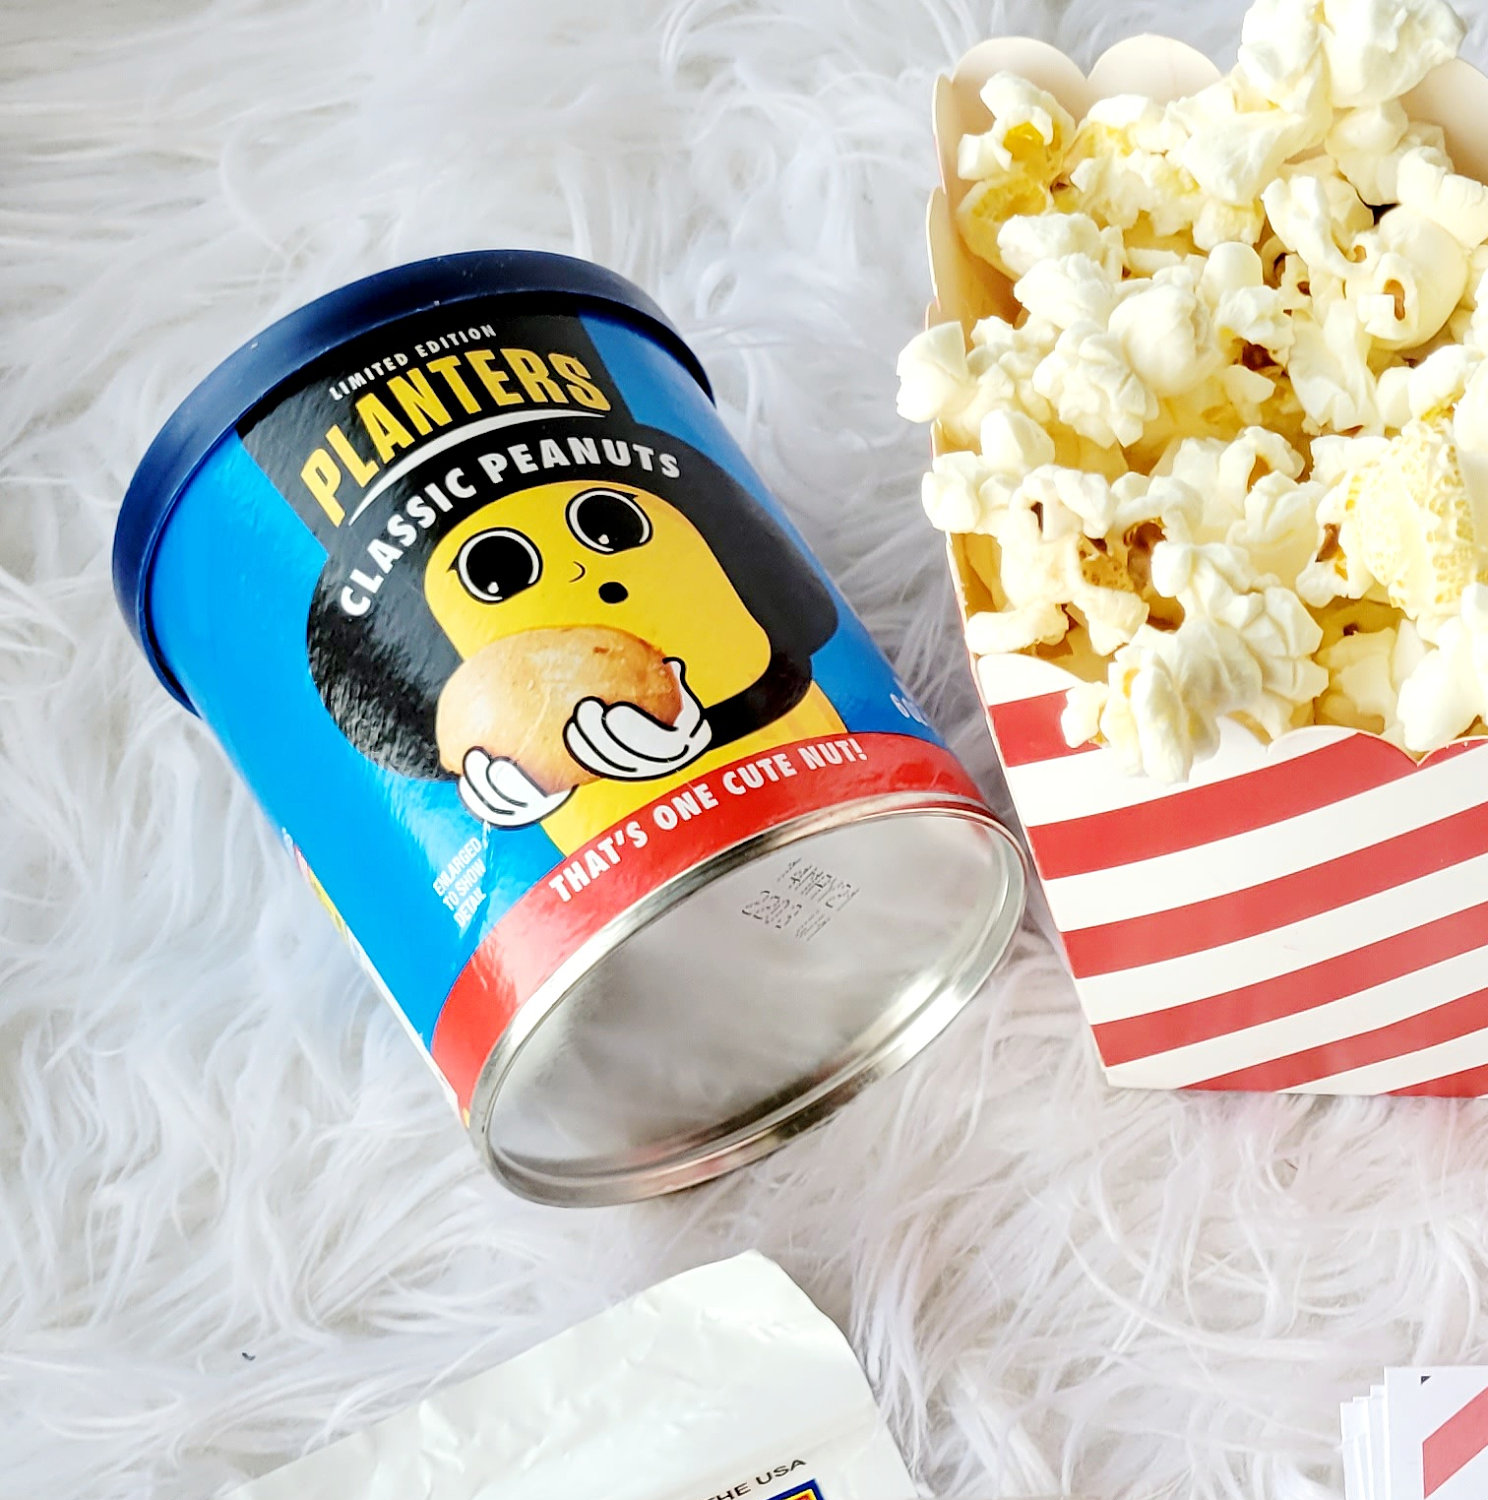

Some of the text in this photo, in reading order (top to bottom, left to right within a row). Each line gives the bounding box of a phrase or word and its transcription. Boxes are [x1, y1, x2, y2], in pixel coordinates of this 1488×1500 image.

[328, 323, 498, 400] LIMITED EDITION
[300, 348, 611, 527] PLANTERS
[339, 437, 681, 617] CLASSIC PEANUTS
[548, 737, 868, 903] THAT'S ONE CUTE NUT!
[433, 837, 481, 896] ENLARGED
[443, 858, 486, 911] TO SHOW
[453, 887, 487, 928] DETAIL
[754, 1458, 808, 1487] USA
